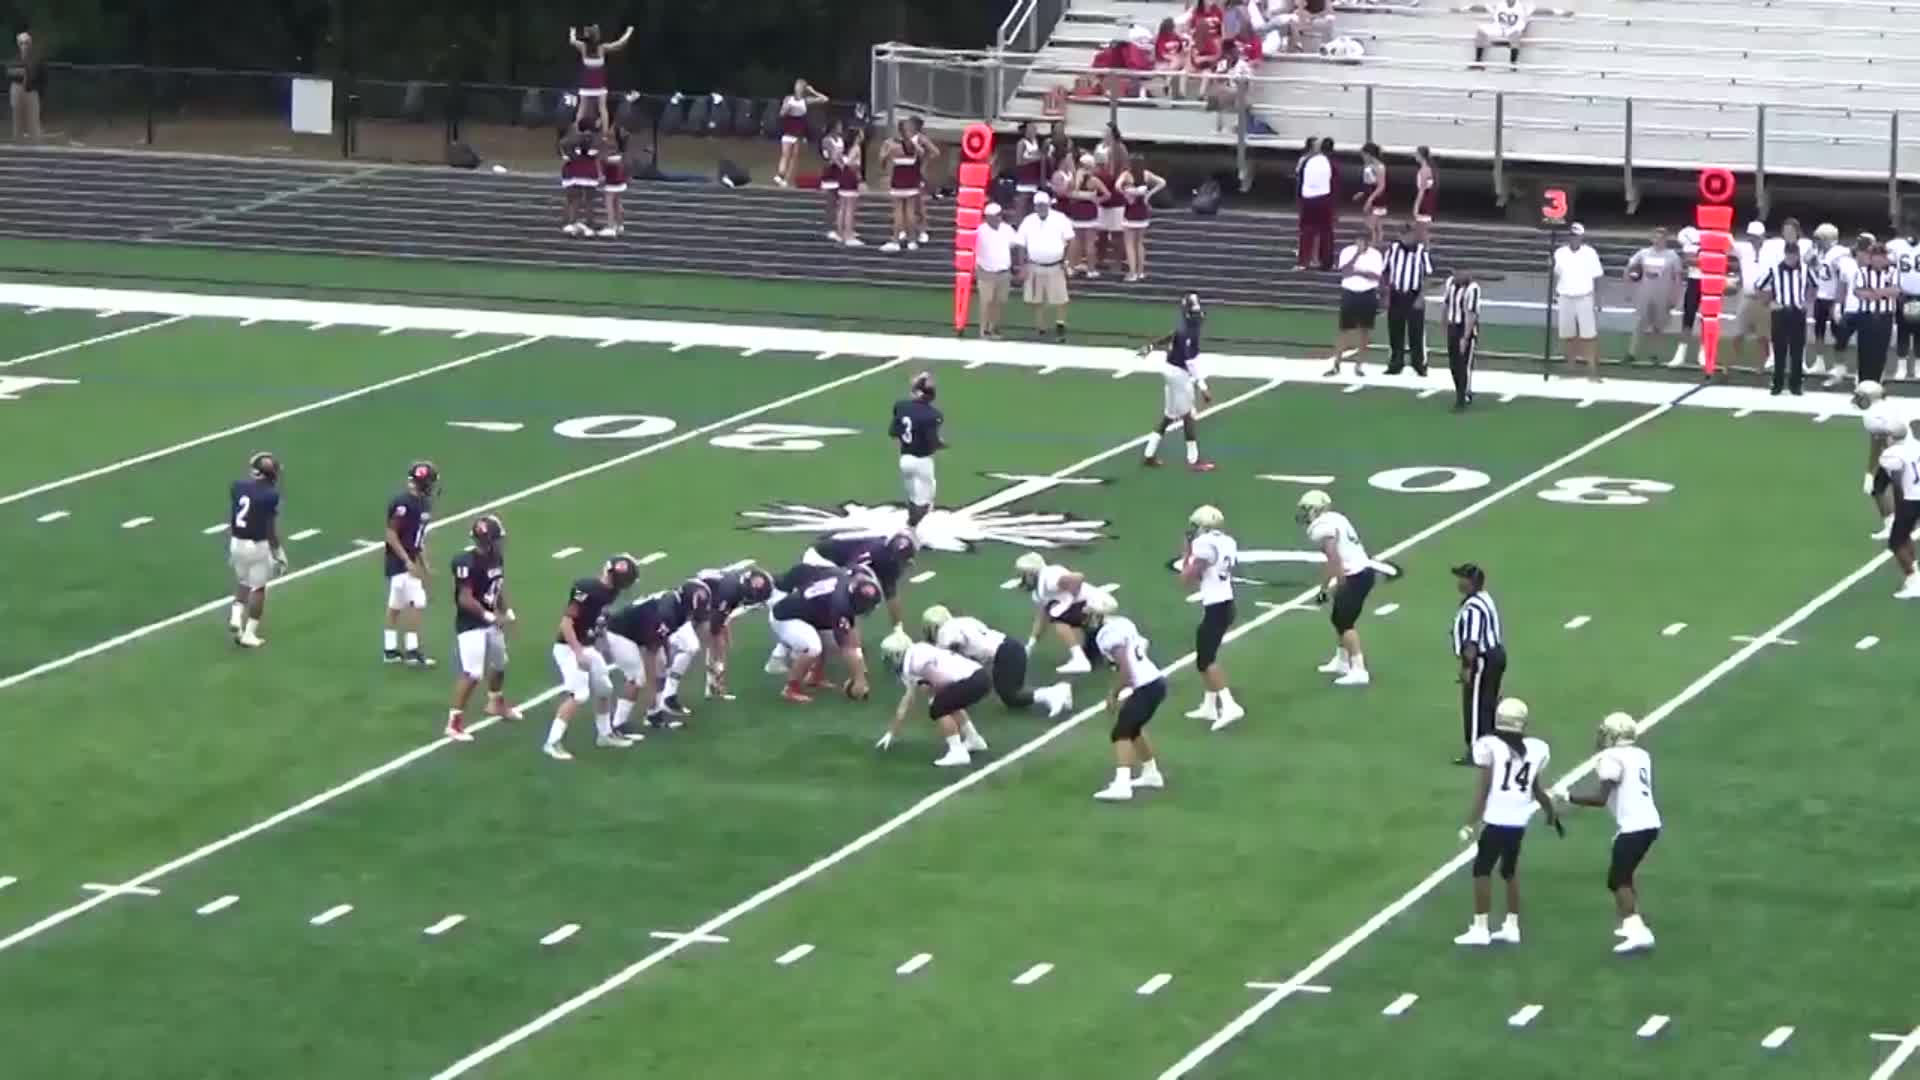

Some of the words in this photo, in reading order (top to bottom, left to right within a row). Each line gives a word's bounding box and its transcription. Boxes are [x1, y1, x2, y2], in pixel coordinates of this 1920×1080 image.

[1541, 189, 1569, 218] 3
[901, 415, 913, 444] 3
[235, 494, 251, 528] 2
[1500, 760, 1532, 793] 14
